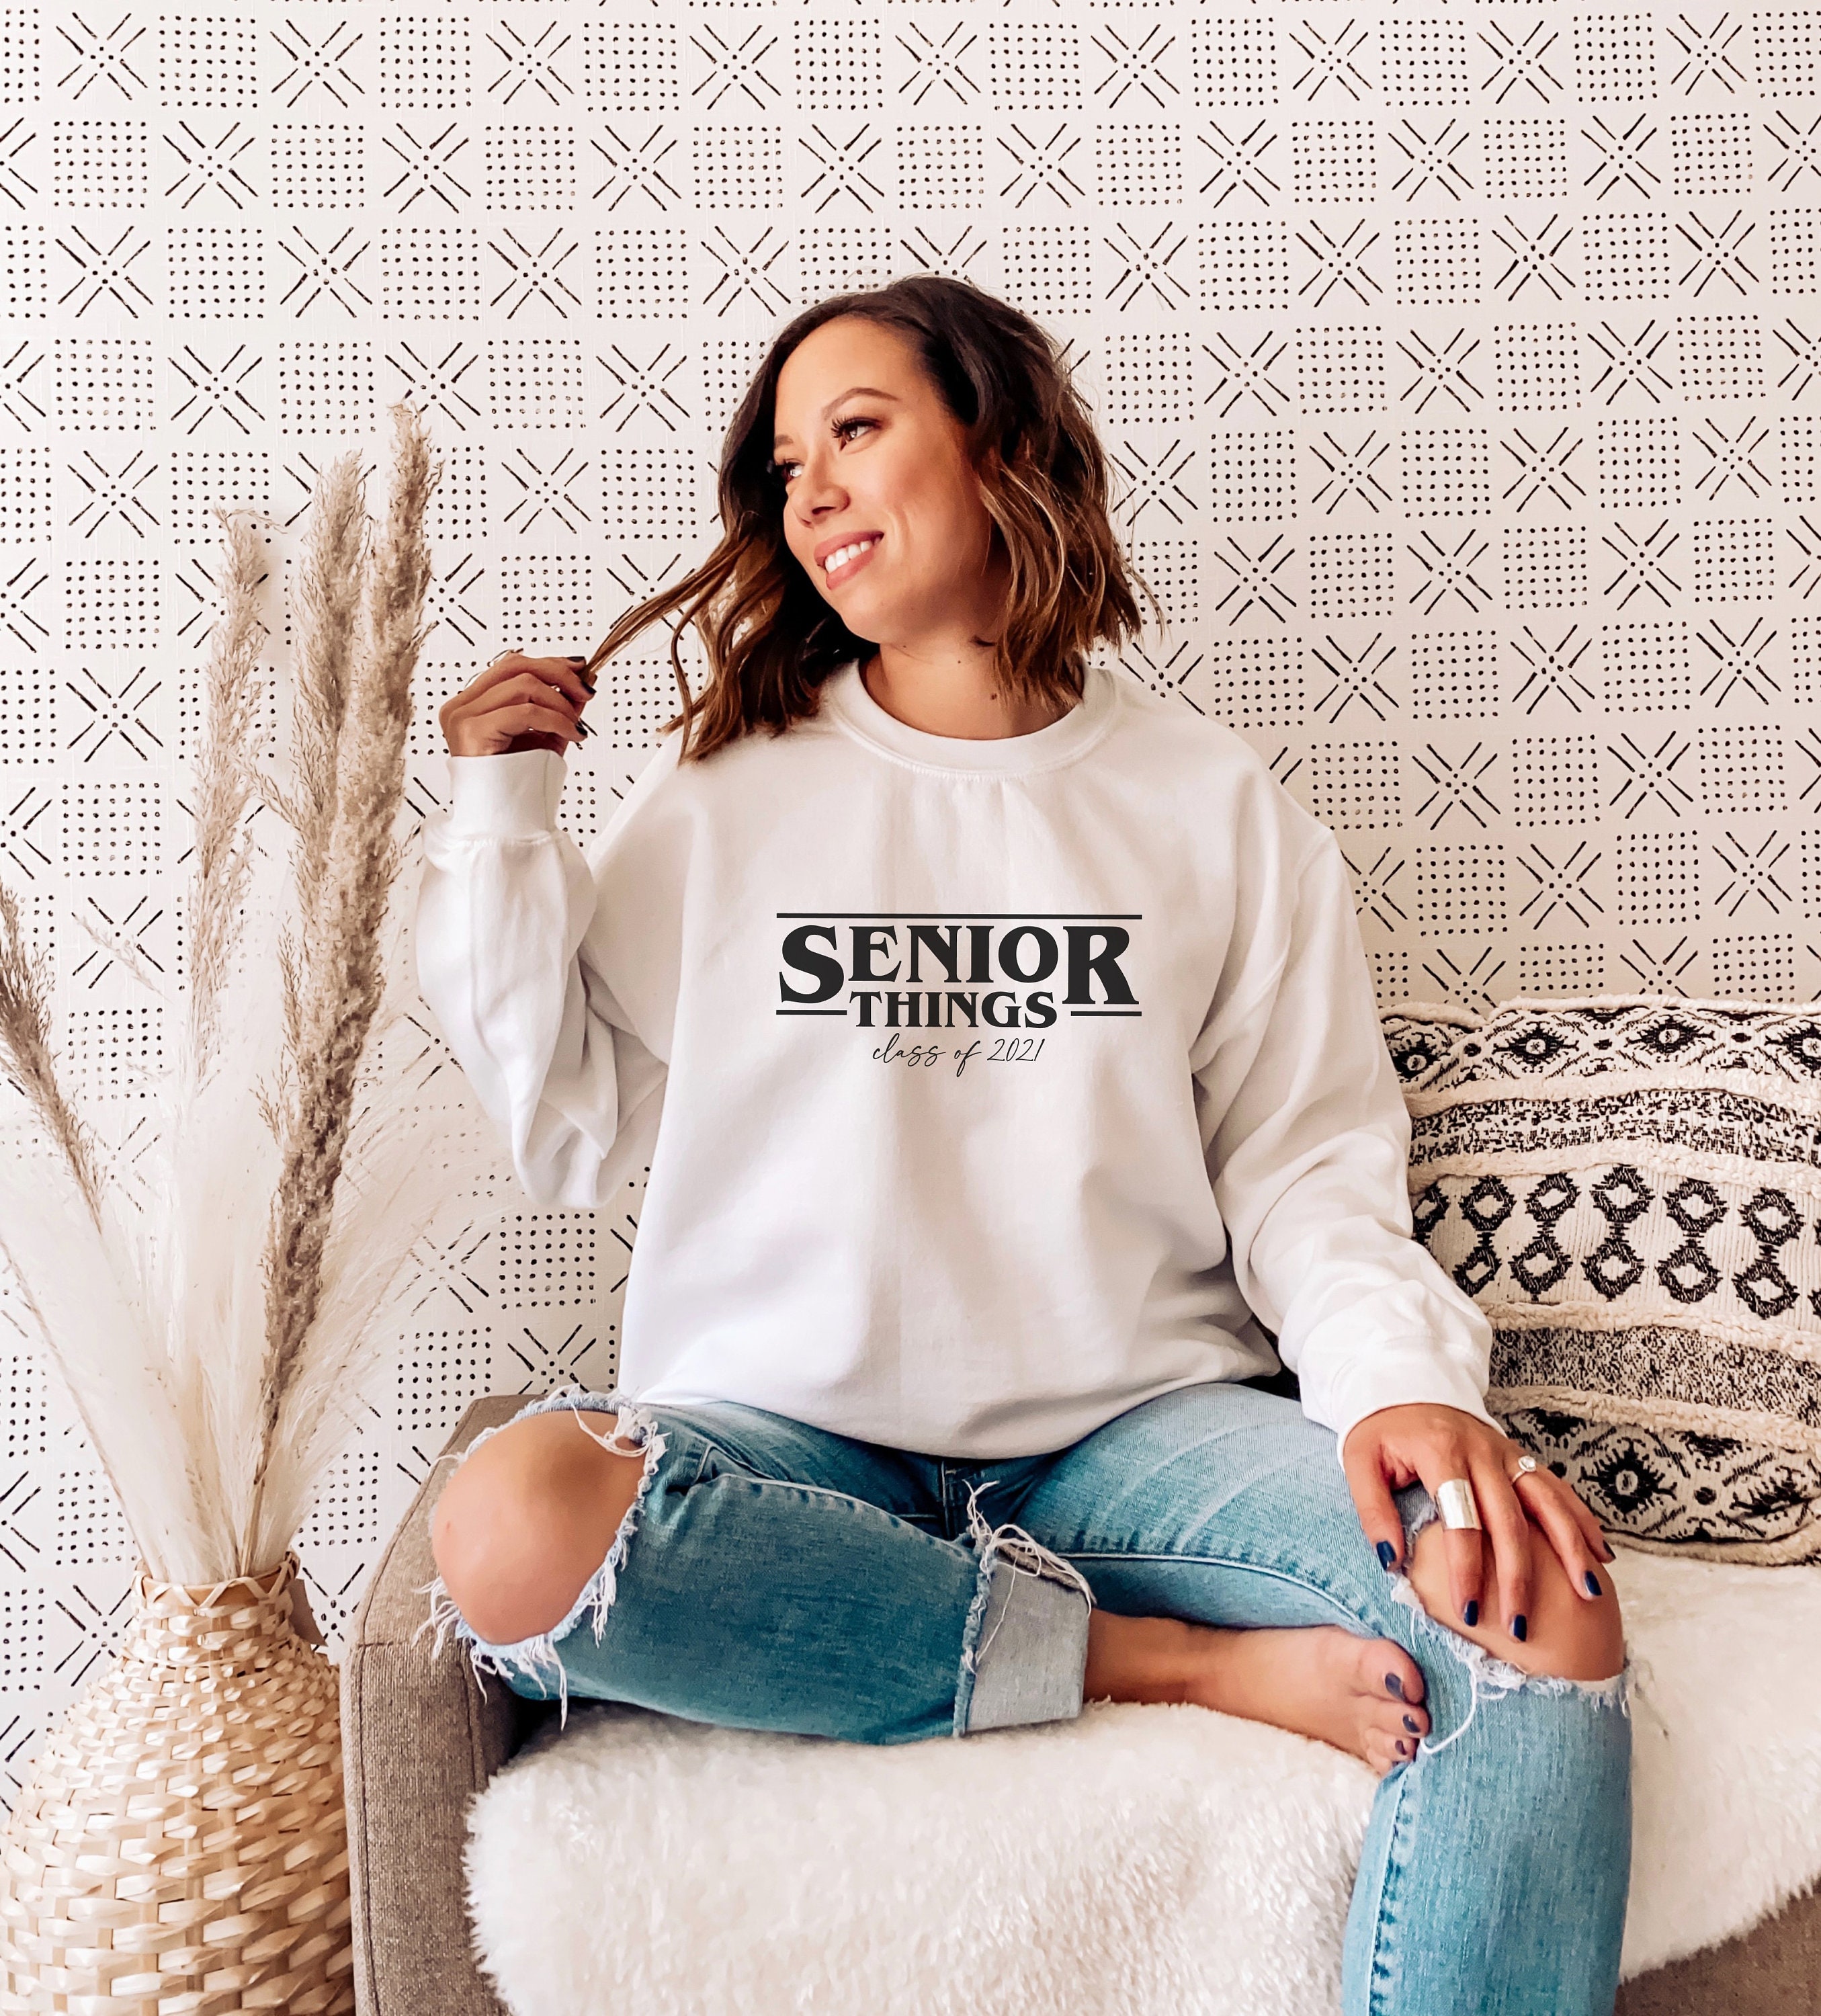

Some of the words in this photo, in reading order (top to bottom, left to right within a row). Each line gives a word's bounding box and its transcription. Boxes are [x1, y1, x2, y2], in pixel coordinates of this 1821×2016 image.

[778, 925, 1140, 1005] SENIOR
[849, 991, 1058, 1029] THINGS
[872, 1032, 947, 1067] class
[954, 1038, 982, 1078] of
[986, 1038, 1046, 1062] 2021
